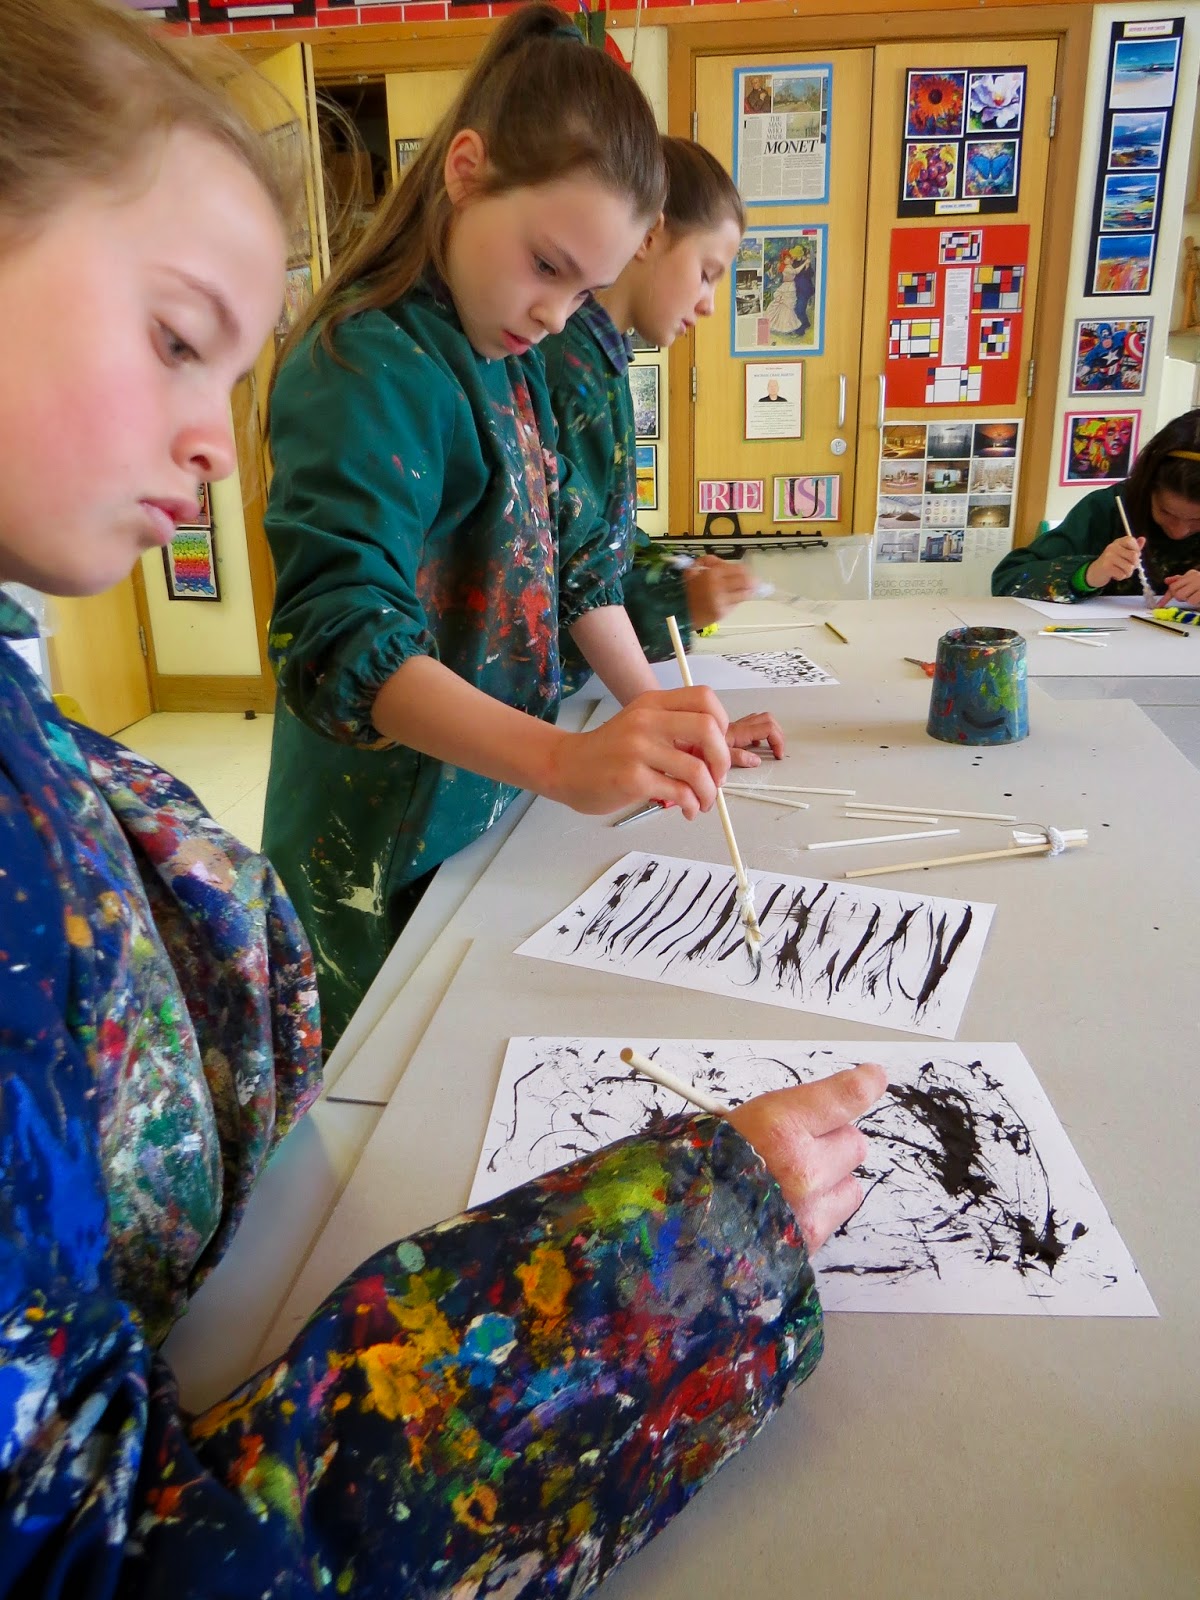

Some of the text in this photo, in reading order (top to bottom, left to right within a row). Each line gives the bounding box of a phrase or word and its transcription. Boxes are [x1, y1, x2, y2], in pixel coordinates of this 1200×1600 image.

[763, 139, 819, 155] MONET
[874, 580, 944, 588] BALTIC CENTRE FOR
[873, 588, 949, 597] CONTEMPORARY ART
